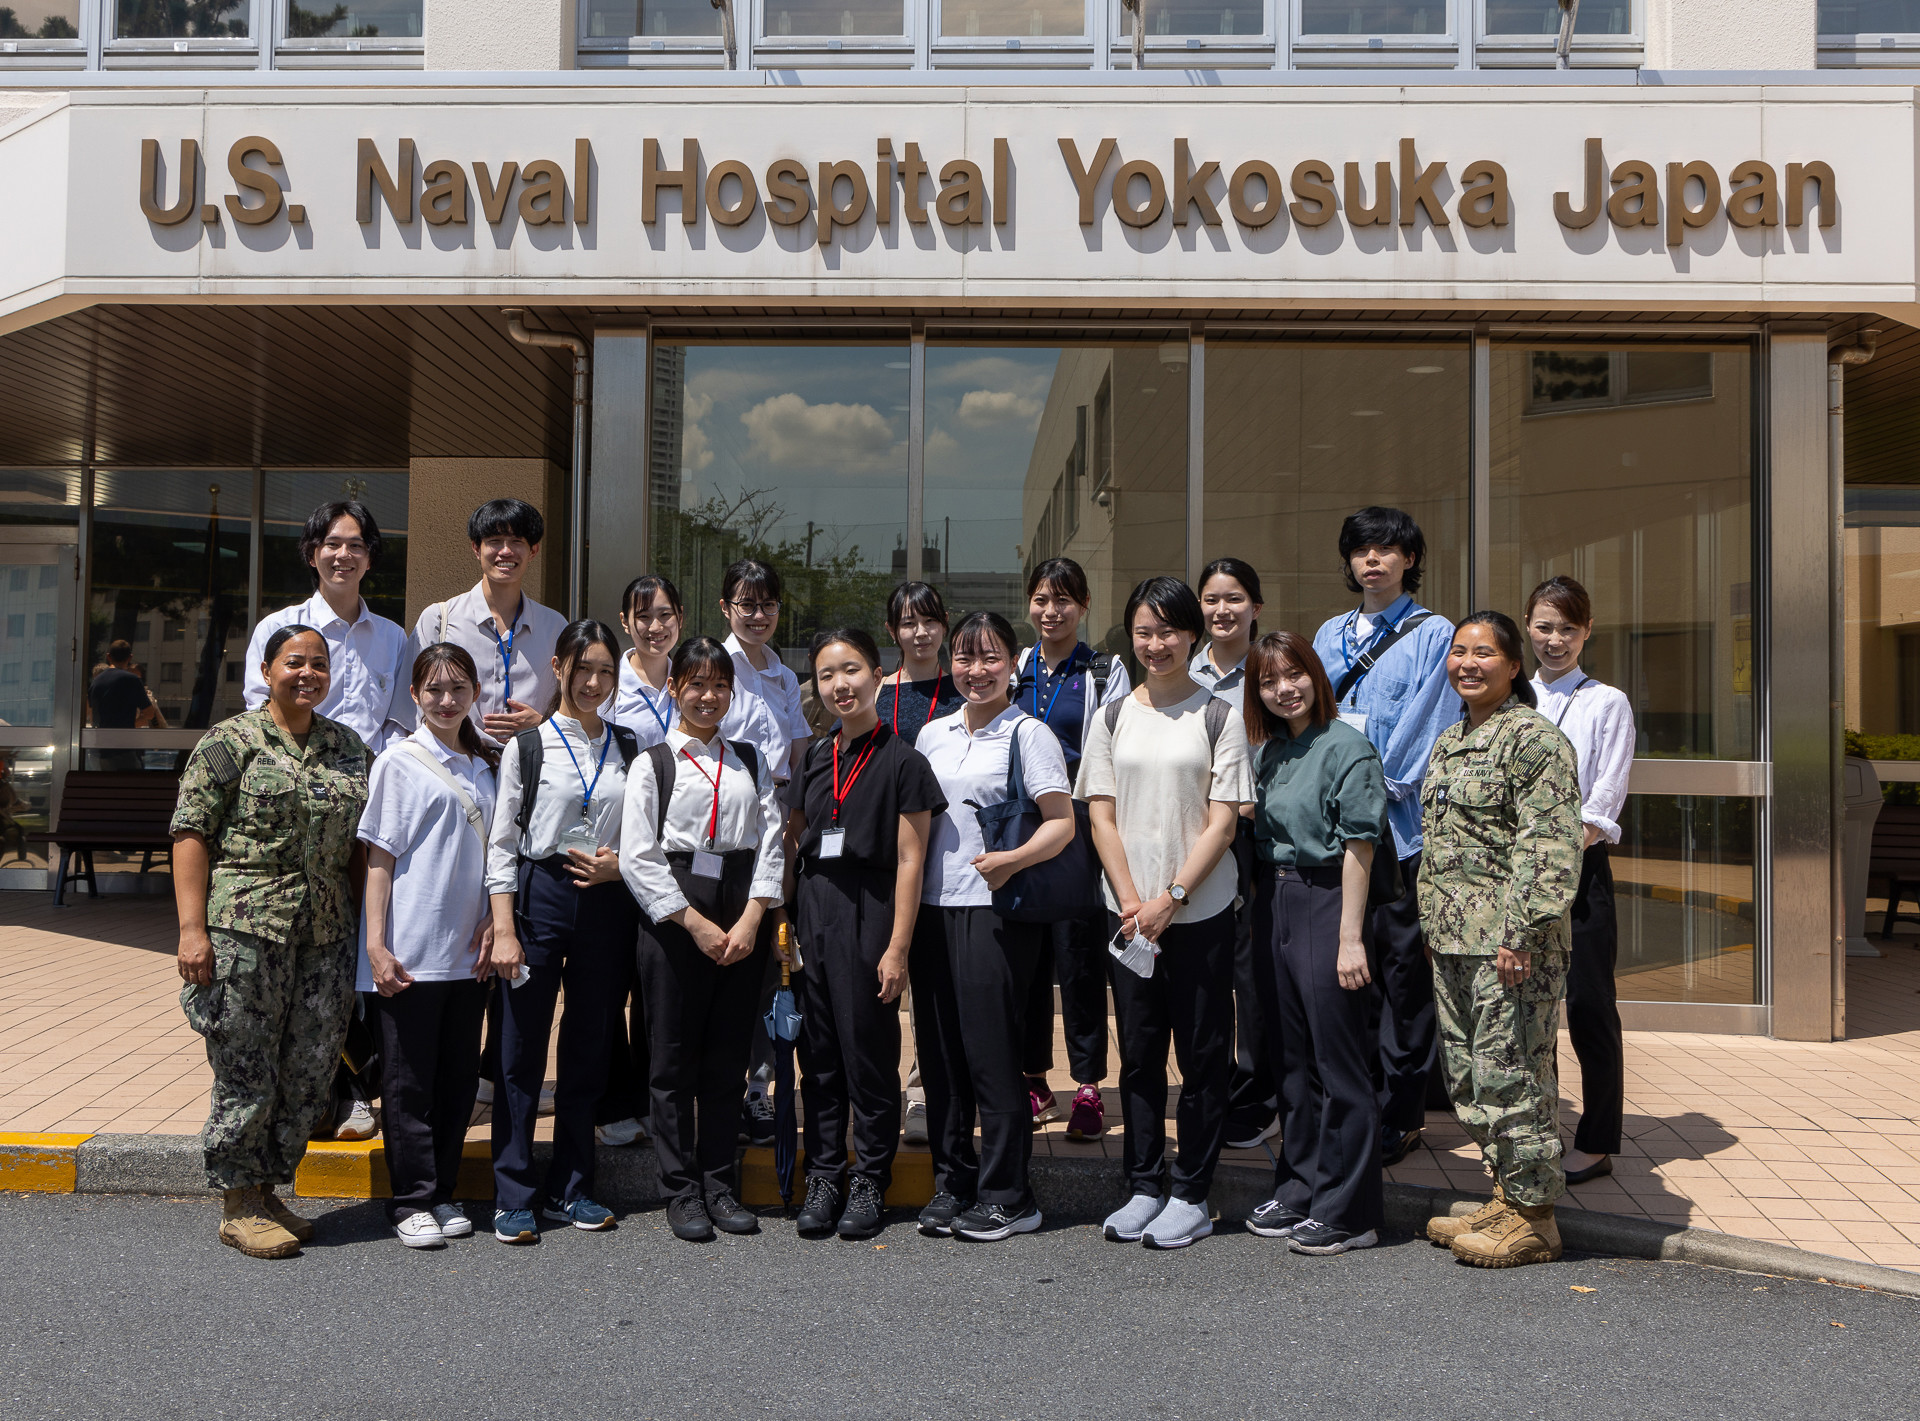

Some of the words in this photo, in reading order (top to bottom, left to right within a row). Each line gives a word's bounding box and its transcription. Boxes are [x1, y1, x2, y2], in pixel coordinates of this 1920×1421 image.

[139, 136, 304, 226] U.S.
[356, 138, 590, 225] Naval
[641, 138, 1008, 245] Hospital
[1058, 138, 1508, 230] Yokosuka
[1553, 138, 1837, 247] Japan
[257, 757, 276, 766] REED
[1474, 769, 1493, 778] NAVY
